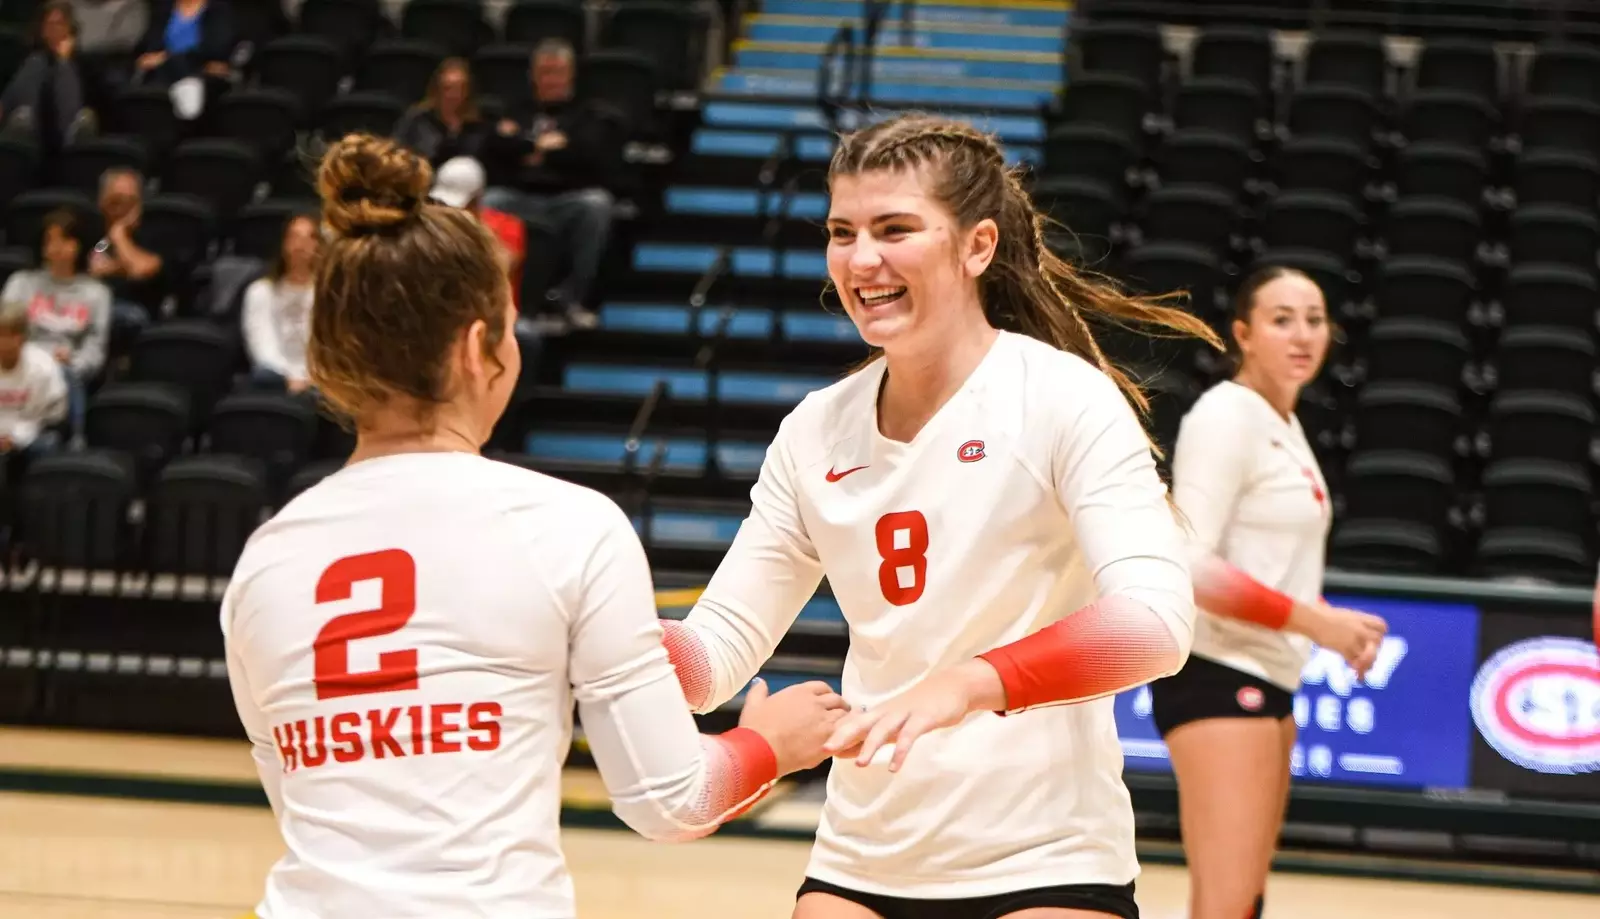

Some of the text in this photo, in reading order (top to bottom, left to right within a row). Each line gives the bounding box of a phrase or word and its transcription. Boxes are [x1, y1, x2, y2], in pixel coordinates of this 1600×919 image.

[875, 510, 929, 607] 8
[313, 548, 419, 700] 2
[273, 701, 503, 774] HUSKIES
